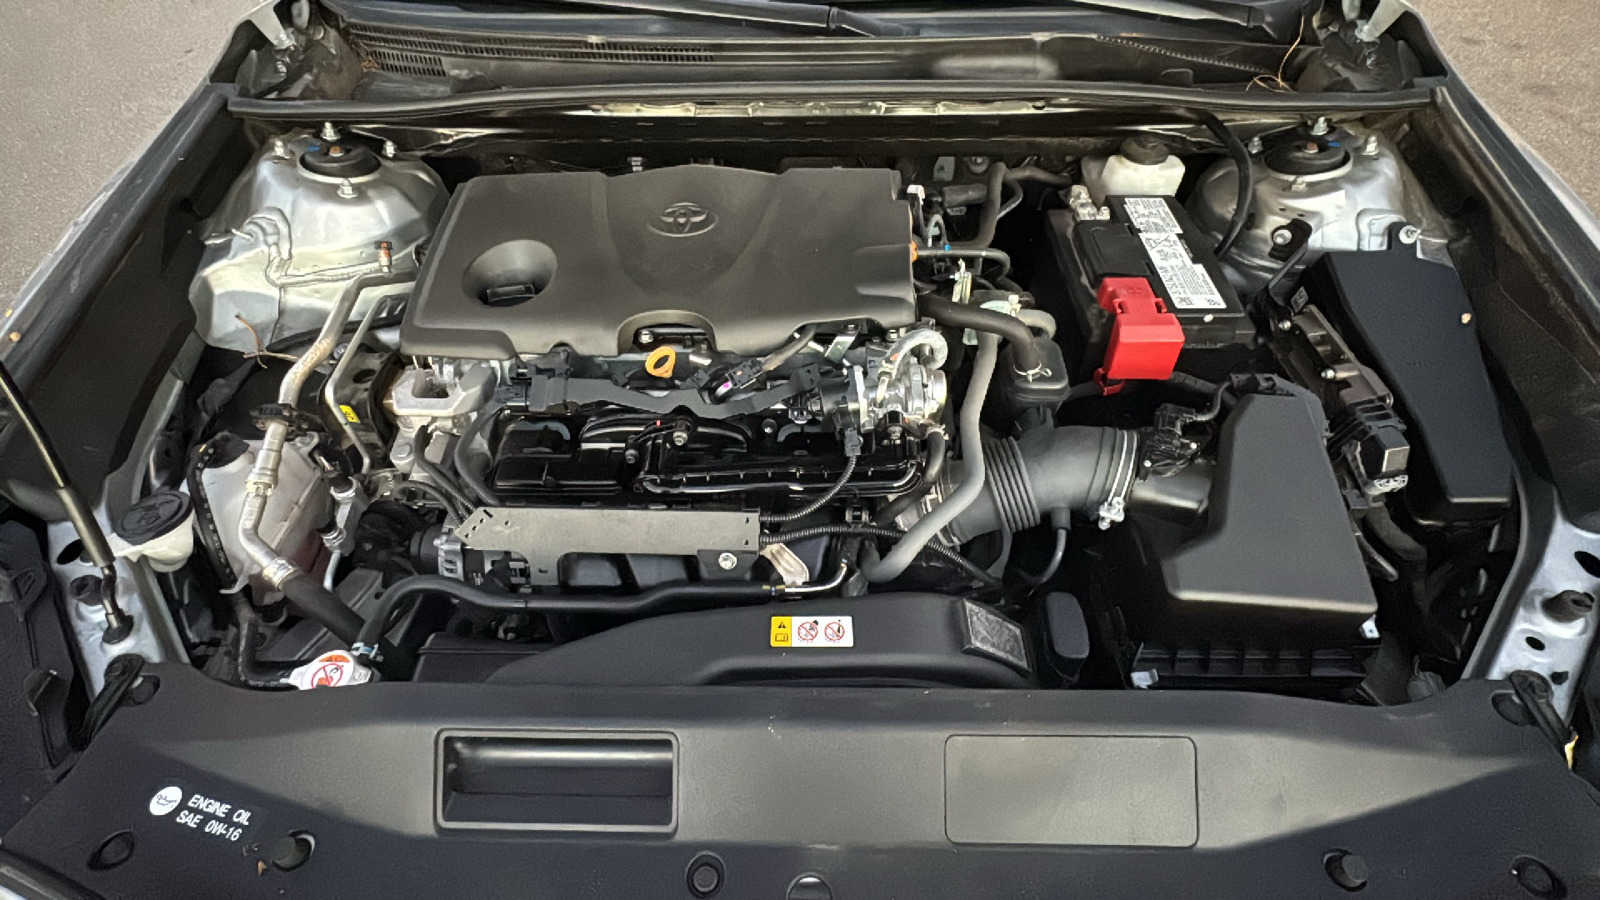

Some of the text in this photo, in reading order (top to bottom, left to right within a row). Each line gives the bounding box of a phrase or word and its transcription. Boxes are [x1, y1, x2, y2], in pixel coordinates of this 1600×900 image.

[175, 809, 243, 842] SAE 0W-16
[187, 794, 252, 826] ENGINE OIL
